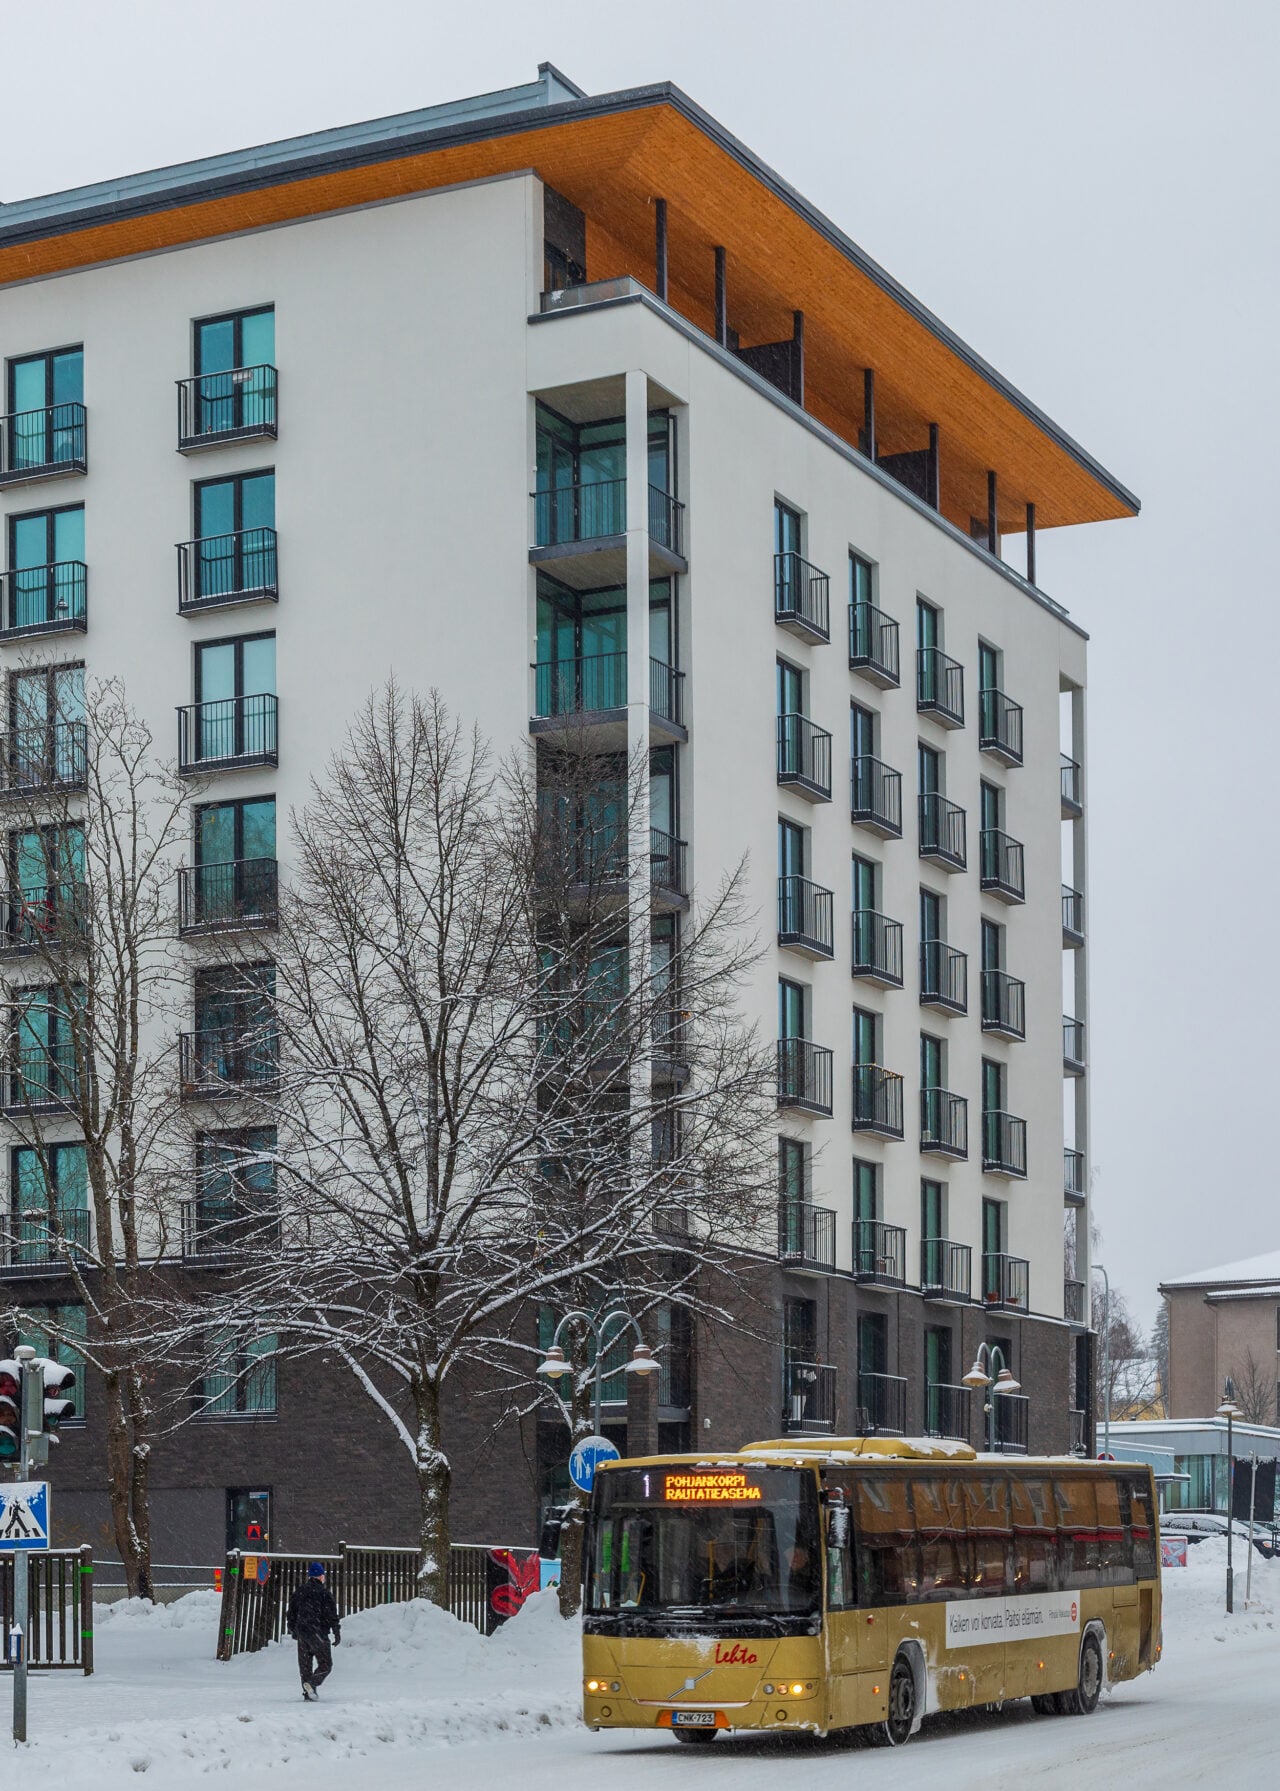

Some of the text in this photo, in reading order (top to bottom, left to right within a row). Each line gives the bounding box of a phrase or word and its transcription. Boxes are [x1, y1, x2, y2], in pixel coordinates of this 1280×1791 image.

[642, 1474, 650, 1498] 1
[665, 1475, 746, 1487] POHJANKORPI
[665, 1487, 762, 1500] RAUTATIEASEMA
[715, 1643, 758, 1664] Lehto
[678, 1712, 713, 1723] CNK-723
